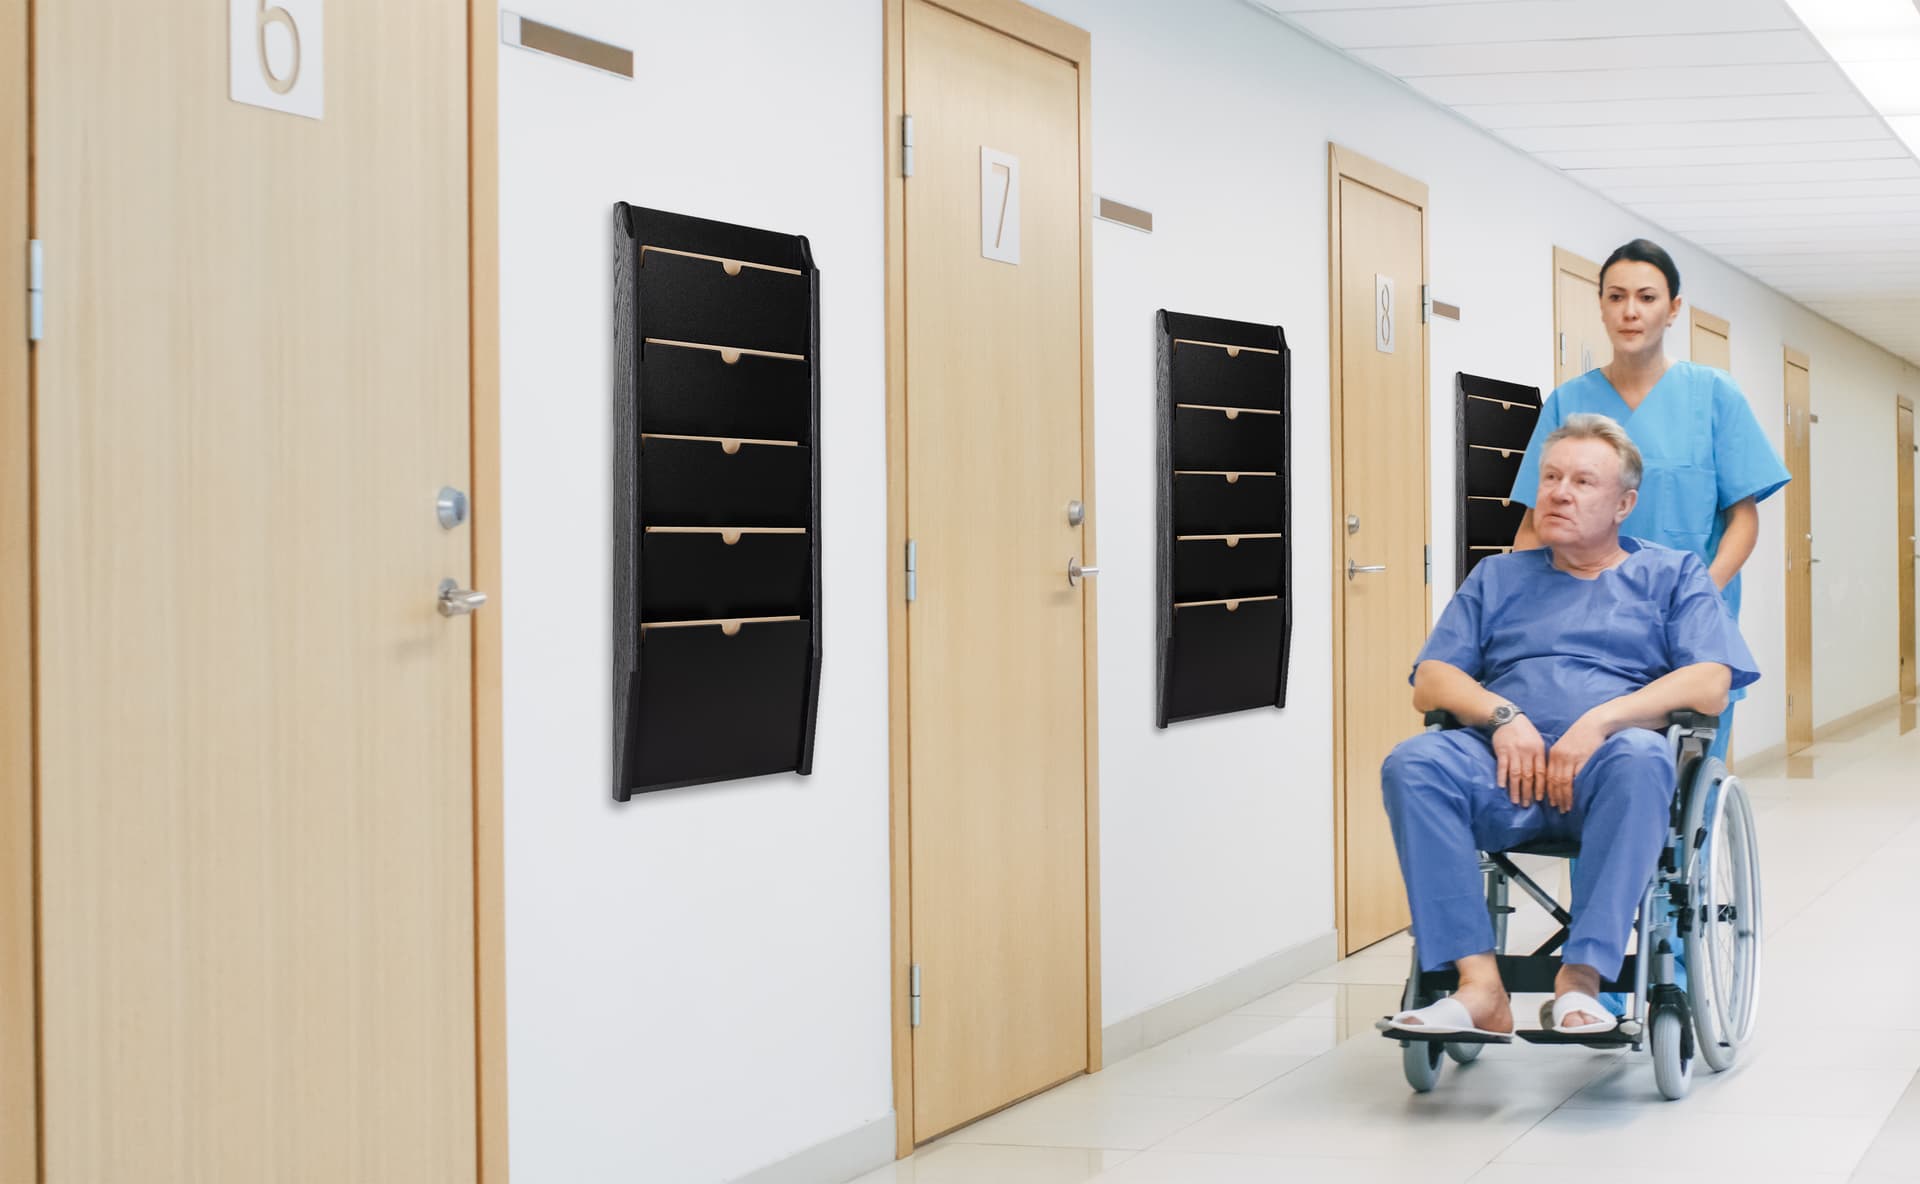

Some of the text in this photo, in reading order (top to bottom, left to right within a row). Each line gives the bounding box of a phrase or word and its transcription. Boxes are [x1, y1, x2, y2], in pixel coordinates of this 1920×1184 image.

[256, 0, 301, 95] 6
[991, 161, 1010, 248] 7
[1381, 284, 1391, 346] 8
